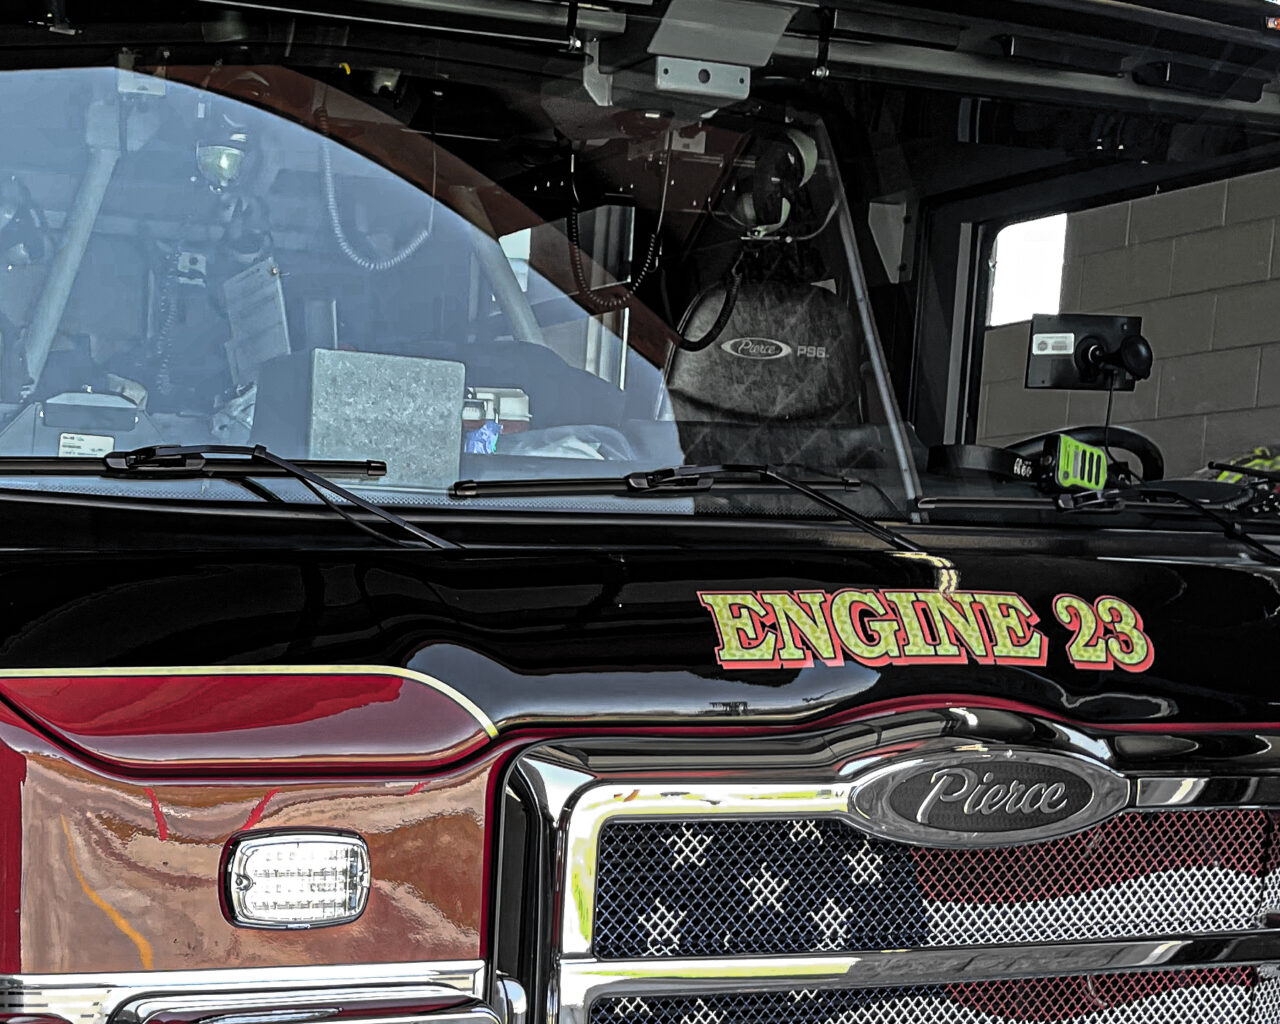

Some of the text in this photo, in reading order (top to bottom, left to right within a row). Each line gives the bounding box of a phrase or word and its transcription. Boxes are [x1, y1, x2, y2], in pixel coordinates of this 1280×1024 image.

[697, 590, 1154, 673] ENGINE 23
[916, 767, 1068, 824] Pierce
